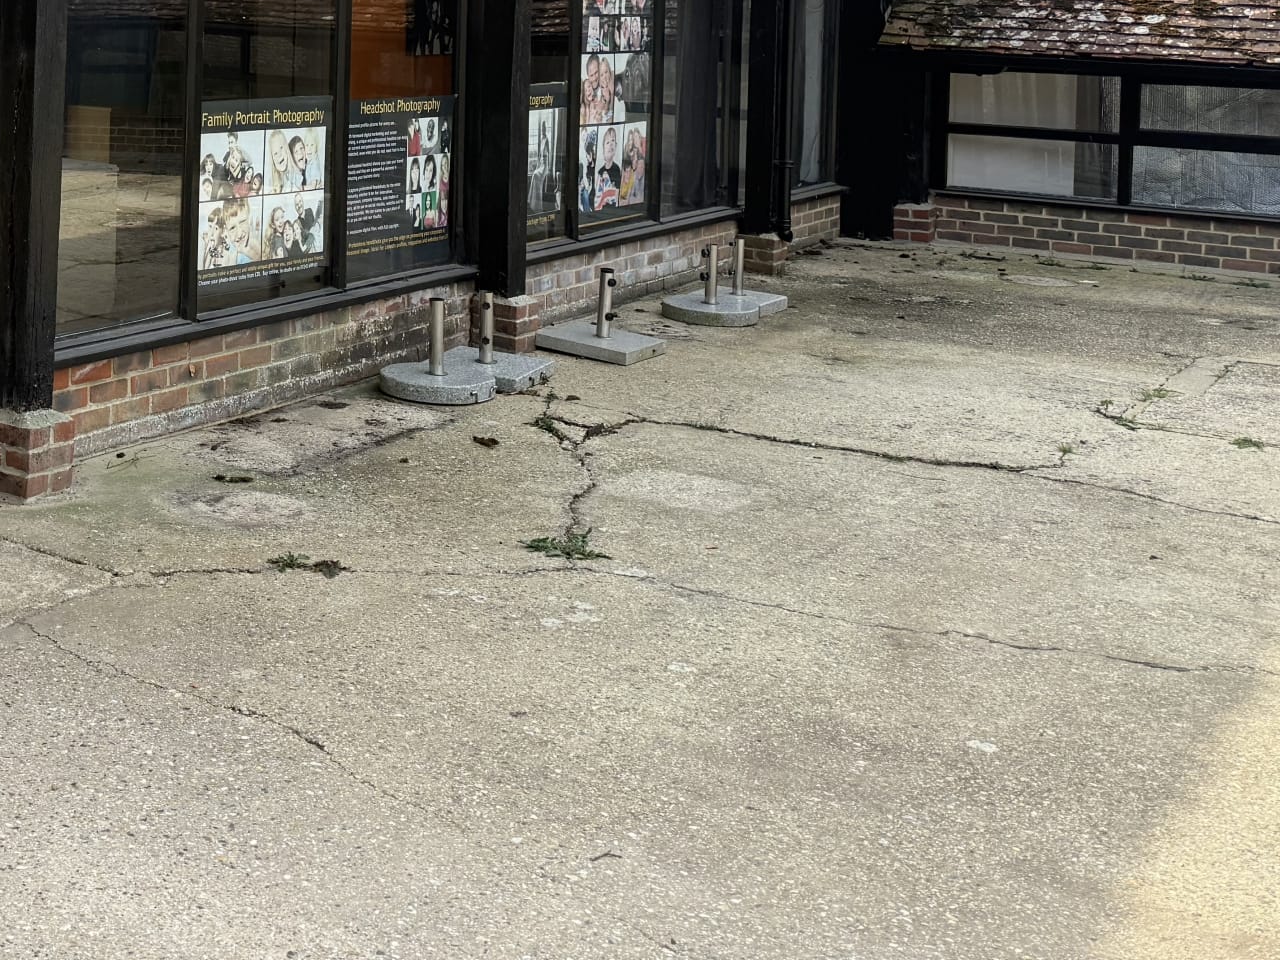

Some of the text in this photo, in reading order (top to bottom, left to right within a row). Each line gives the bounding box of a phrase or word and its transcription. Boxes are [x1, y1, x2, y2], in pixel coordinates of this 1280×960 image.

[360, 98, 441, 115] Headshot Photography
[529, 93, 554, 108] tography
[201, 107, 325, 129] Family Portrait Photography
